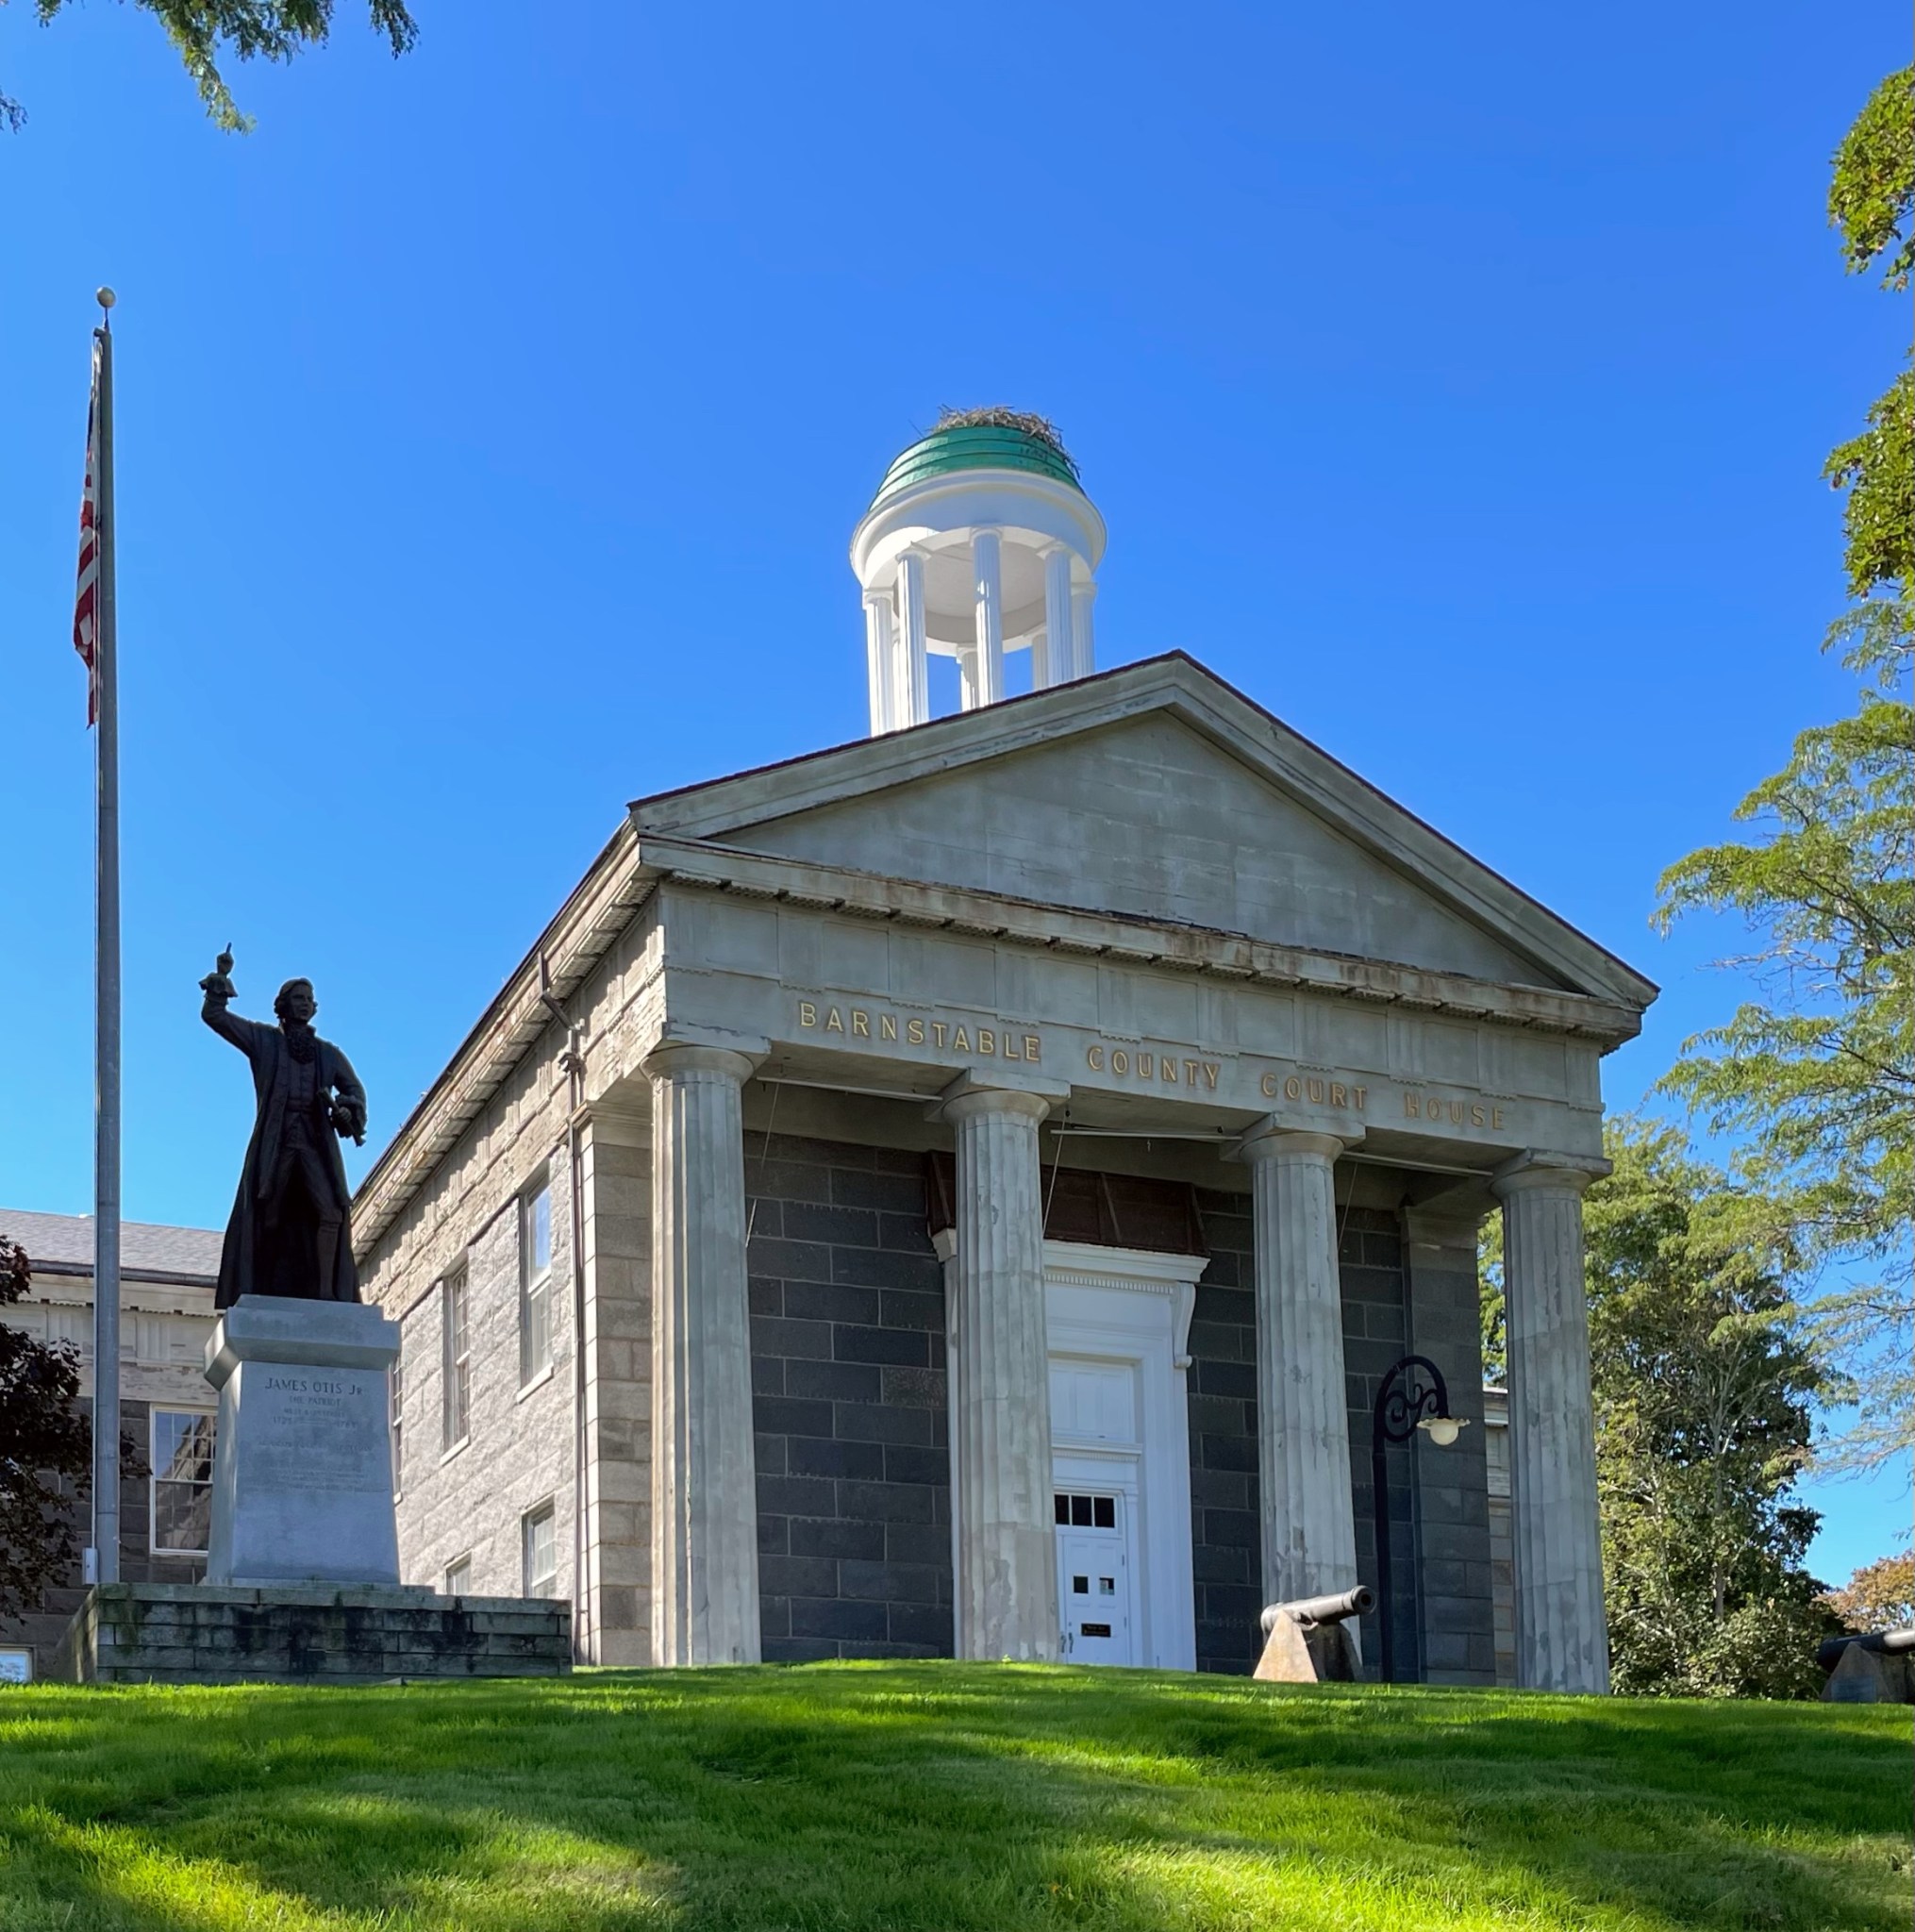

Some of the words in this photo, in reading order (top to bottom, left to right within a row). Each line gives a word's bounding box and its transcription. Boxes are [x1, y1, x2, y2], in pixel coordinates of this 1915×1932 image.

[798, 1001, 1041, 1062] BARNSTABLE
[1087, 1044, 1222, 1090] COUNTY
[1260, 1073, 1368, 1110] COURT
[1403, 1090, 1506, 1131] HOUSE
[264, 1377, 308, 1392] JAMES
[312, 1381, 342, 1394] OTIS
